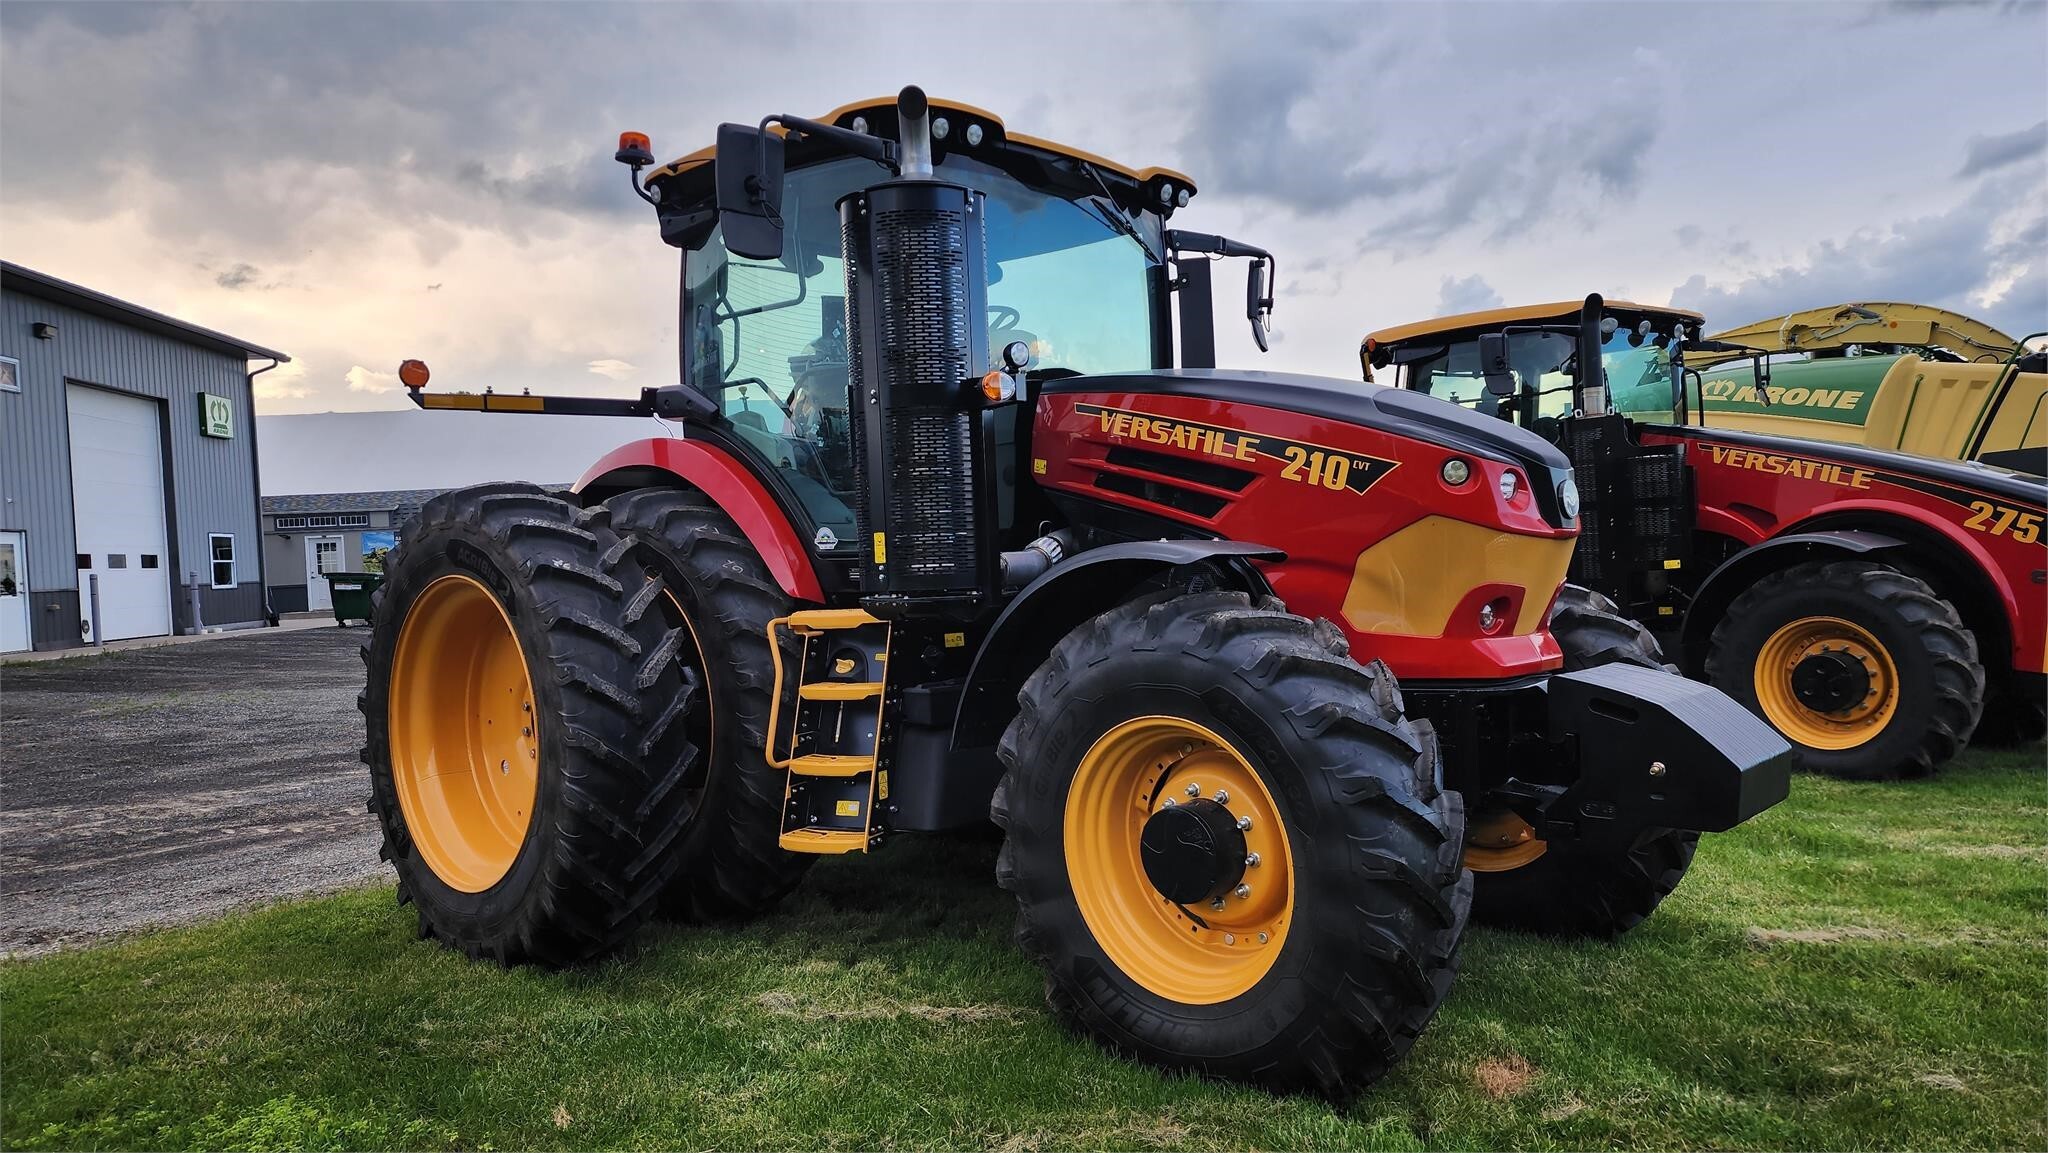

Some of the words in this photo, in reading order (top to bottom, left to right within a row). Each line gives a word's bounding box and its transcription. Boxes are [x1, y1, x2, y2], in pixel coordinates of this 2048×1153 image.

[1732, 385, 1865, 410] KRONE
[1101, 410, 1261, 463] VERSATILE
[1281, 446, 1350, 490] 210
[1352, 460, 1371, 471] CVT
[1712, 447, 1875, 489] VERSATILE
[1963, 501, 2045, 543] 275
